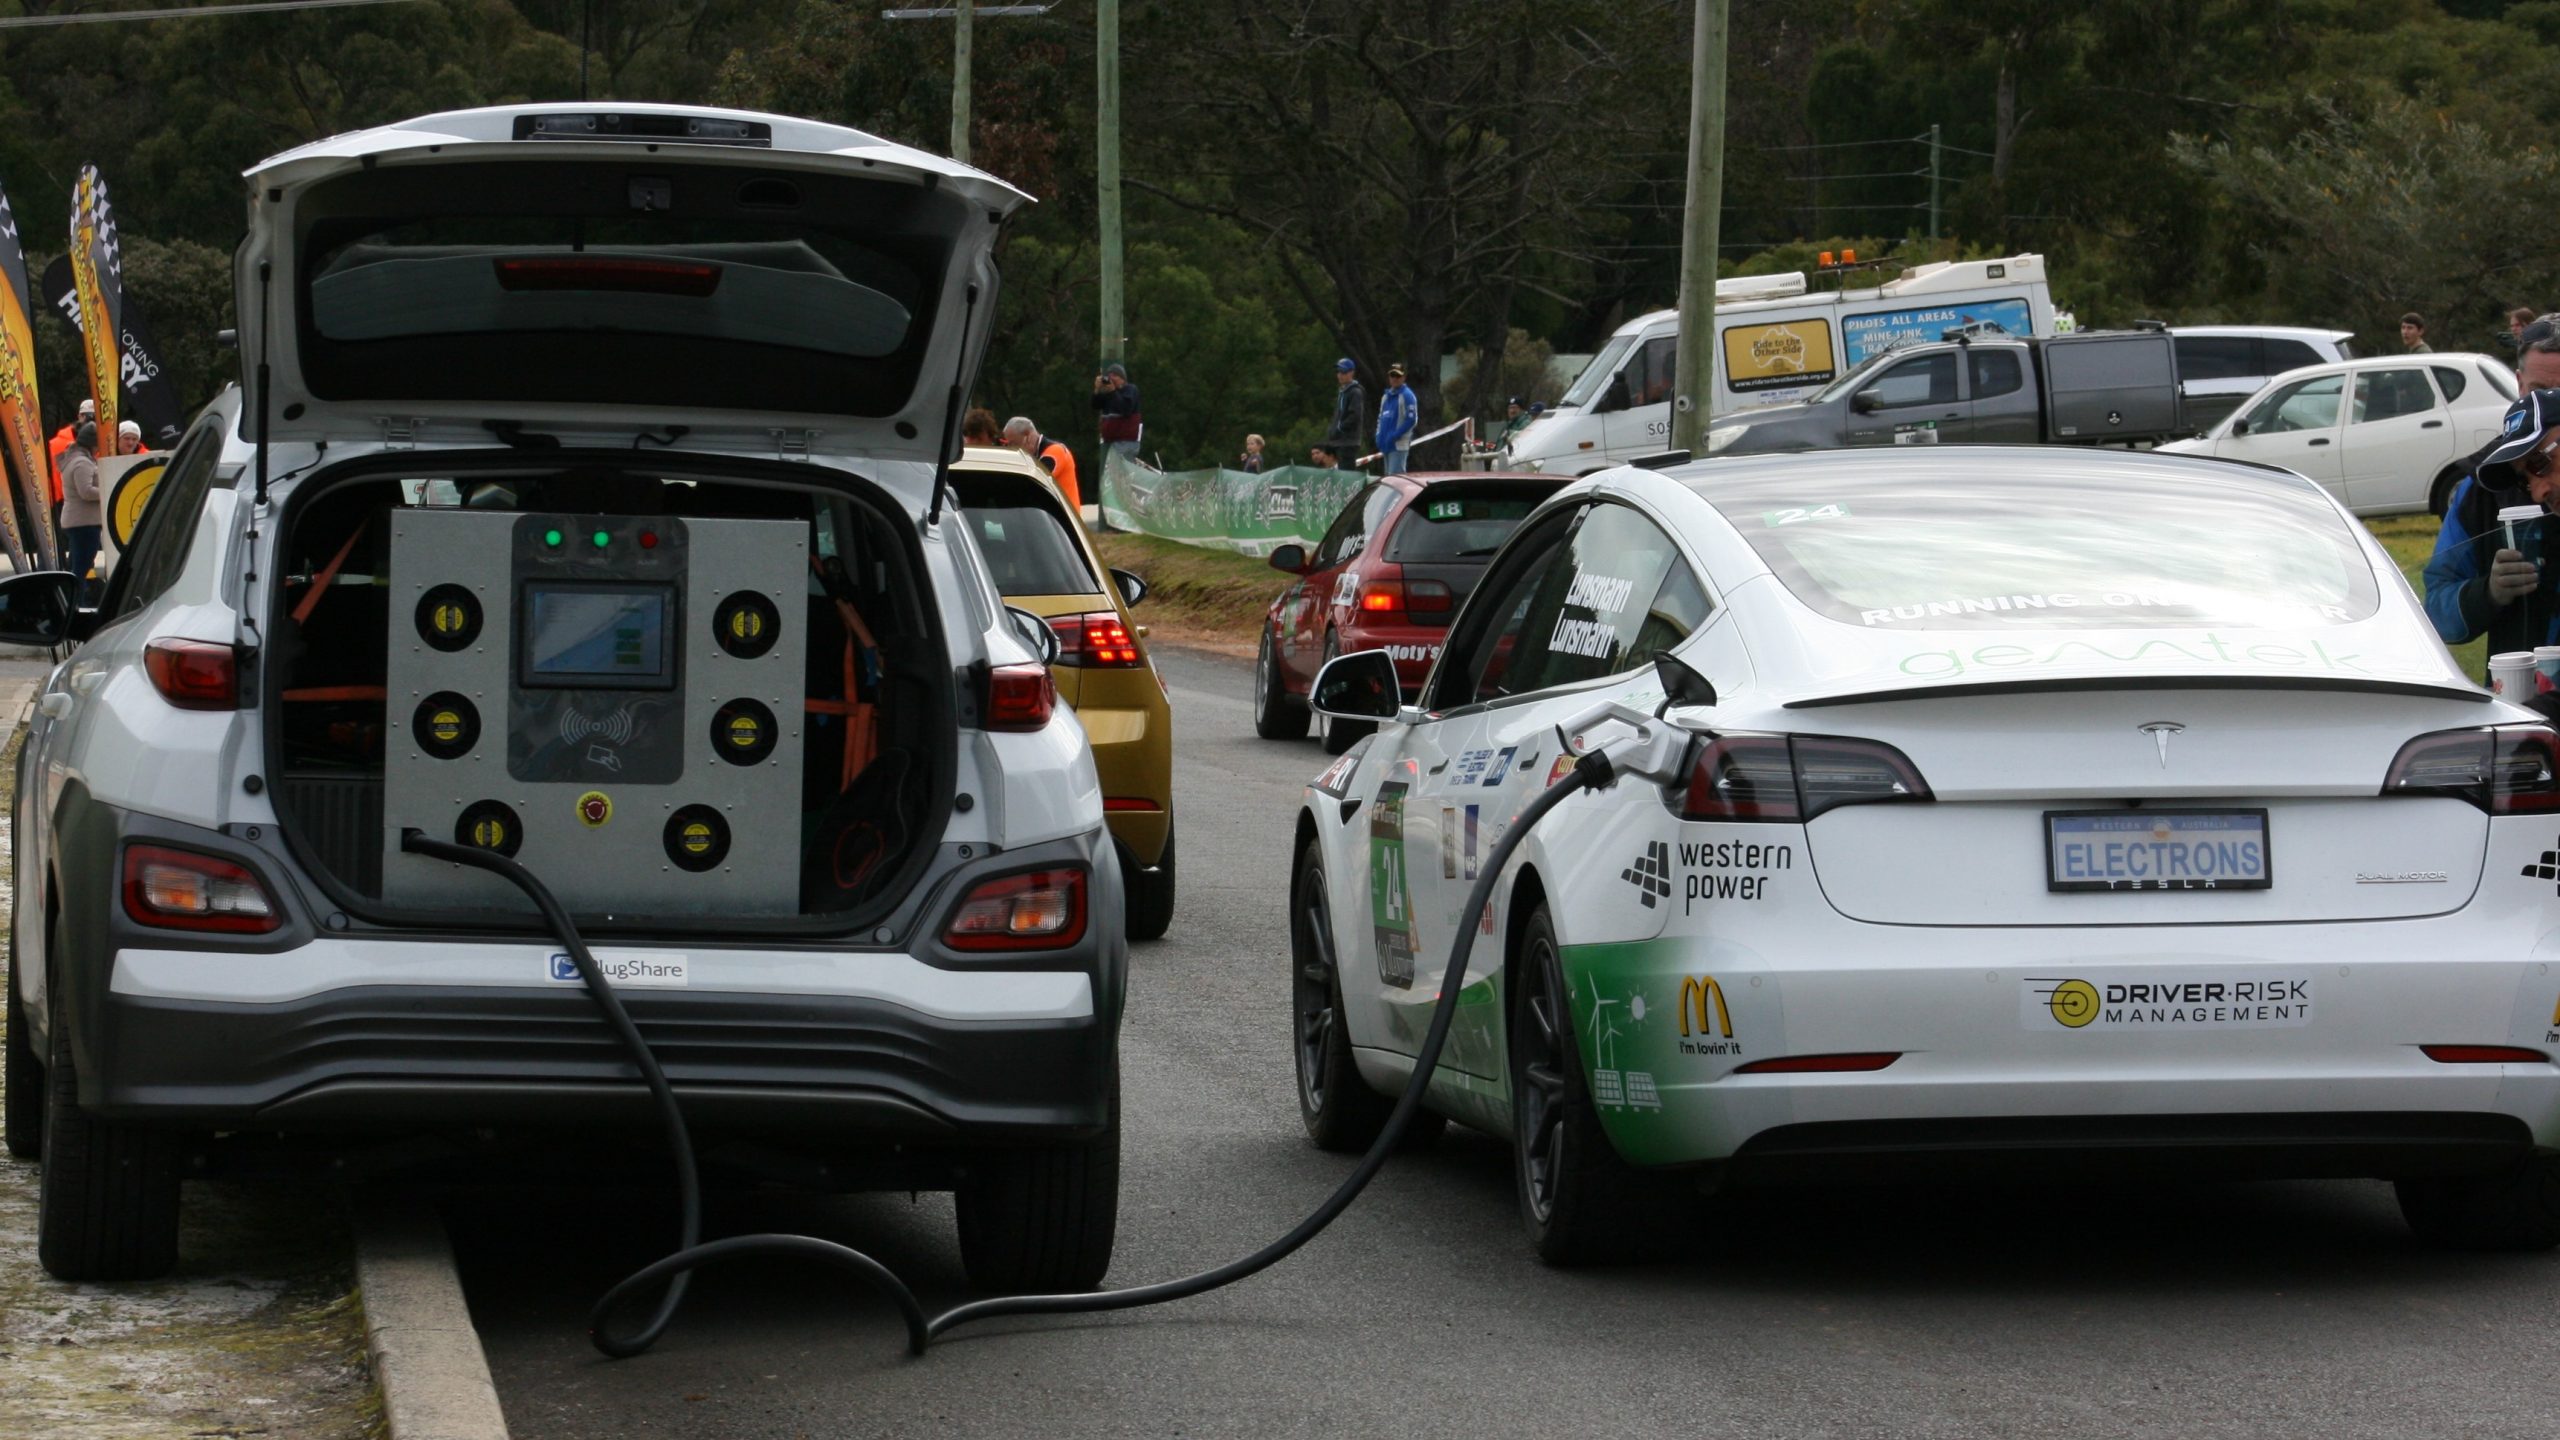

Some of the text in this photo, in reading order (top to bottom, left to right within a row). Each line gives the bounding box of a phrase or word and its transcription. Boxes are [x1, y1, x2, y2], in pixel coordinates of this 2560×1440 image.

[1848, 310, 1956, 329] PILOTS ALL AREAS
[1753, 337, 1801, 350] Ride to the
[1863, 330, 1892, 342] MINE
[1753, 345, 1802, 357] Other Side
[1434, 502, 1461, 516] 18
[1774, 503, 1845, 525] 24
[1565, 562, 1633, 613] Lunsmann
[1861, 592, 2080, 625] RUNNING
[1548, 607, 1615, 659] Lunsmann
[2093, 820, 2230, 830] WESTERN AUSTRALIA
[1680, 839, 1791, 869] western
[2065, 841, 2261, 877] ELECTRONS
[1383, 845, 1403, 921] 24
[2108, 880, 2216, 889] TESLA
[2355, 871, 2448, 880] DUAL MOTOR
[1686, 875, 1768, 916] power
[592, 960, 682, 980] lugShare
[2106, 1005, 2309, 1023] MANAGEMENT
[1696, 1042, 1729, 1055] lovin'
[1731, 1042, 1742, 1055] it
